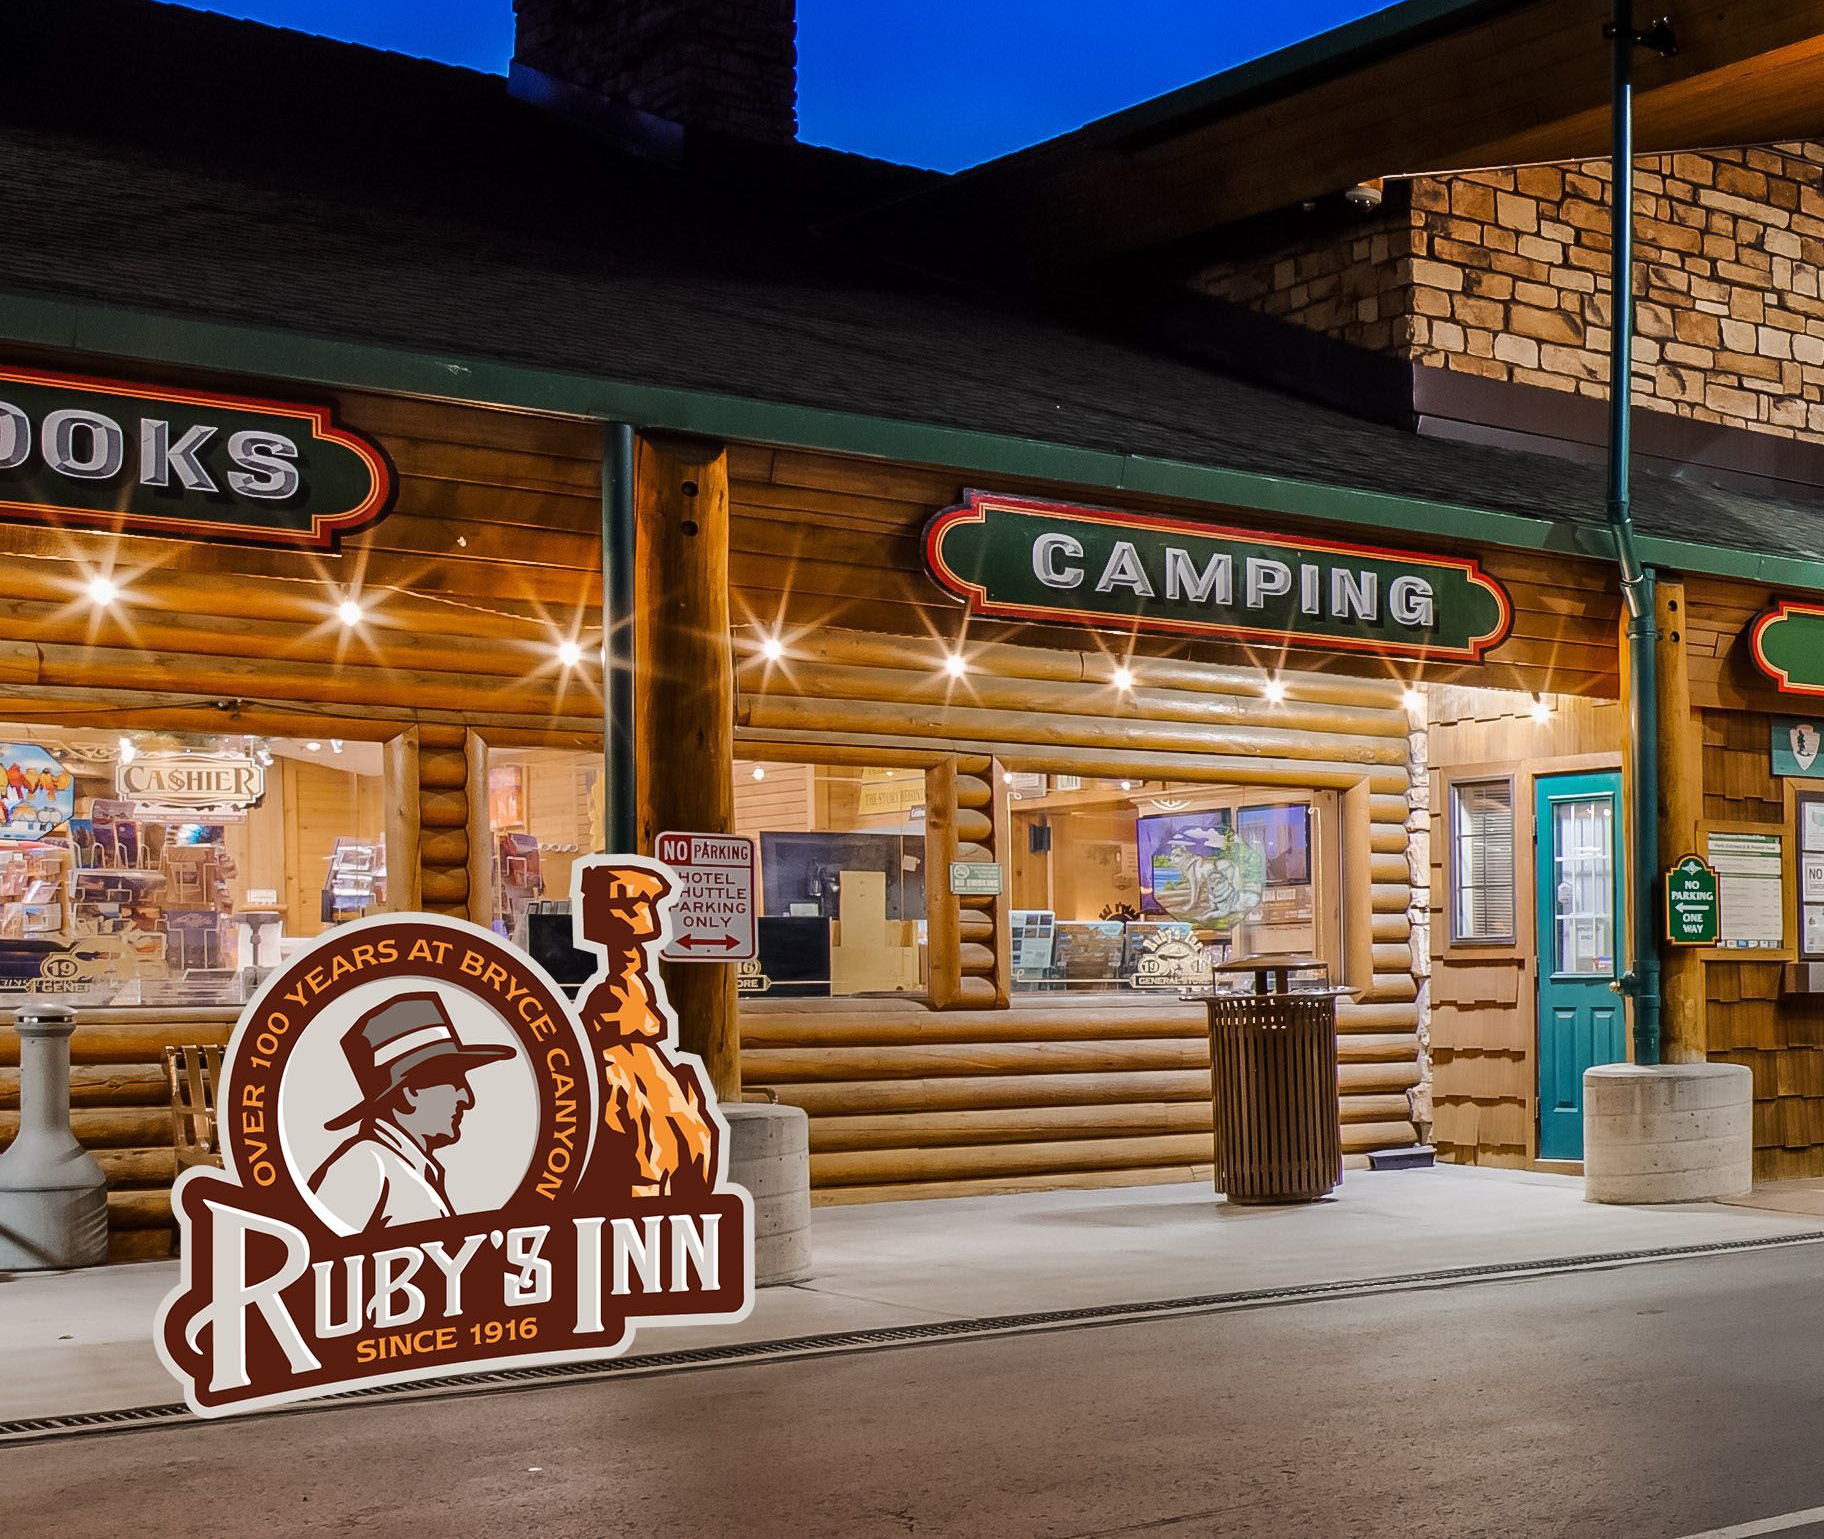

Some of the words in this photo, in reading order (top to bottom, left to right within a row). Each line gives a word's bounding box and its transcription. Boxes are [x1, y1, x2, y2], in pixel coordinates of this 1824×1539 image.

[1033, 533, 1434, 627] CAMPING
[664, 841, 688, 861] NO
[694, 844, 748, 860] PARKING
[679, 872, 736, 885] HOTEL
[1809, 868, 1823, 879] NO
[1685, 881, 1700, 889] NO
[680, 887, 747, 900] HUTTLE
[1671, 891, 1714, 901] PARKING
[683, 916, 732, 928] ONLY
[1683, 913, 1704, 923] ONE
[1683, 924, 1704, 933] WAY
[49, 962, 71, 976] 19
